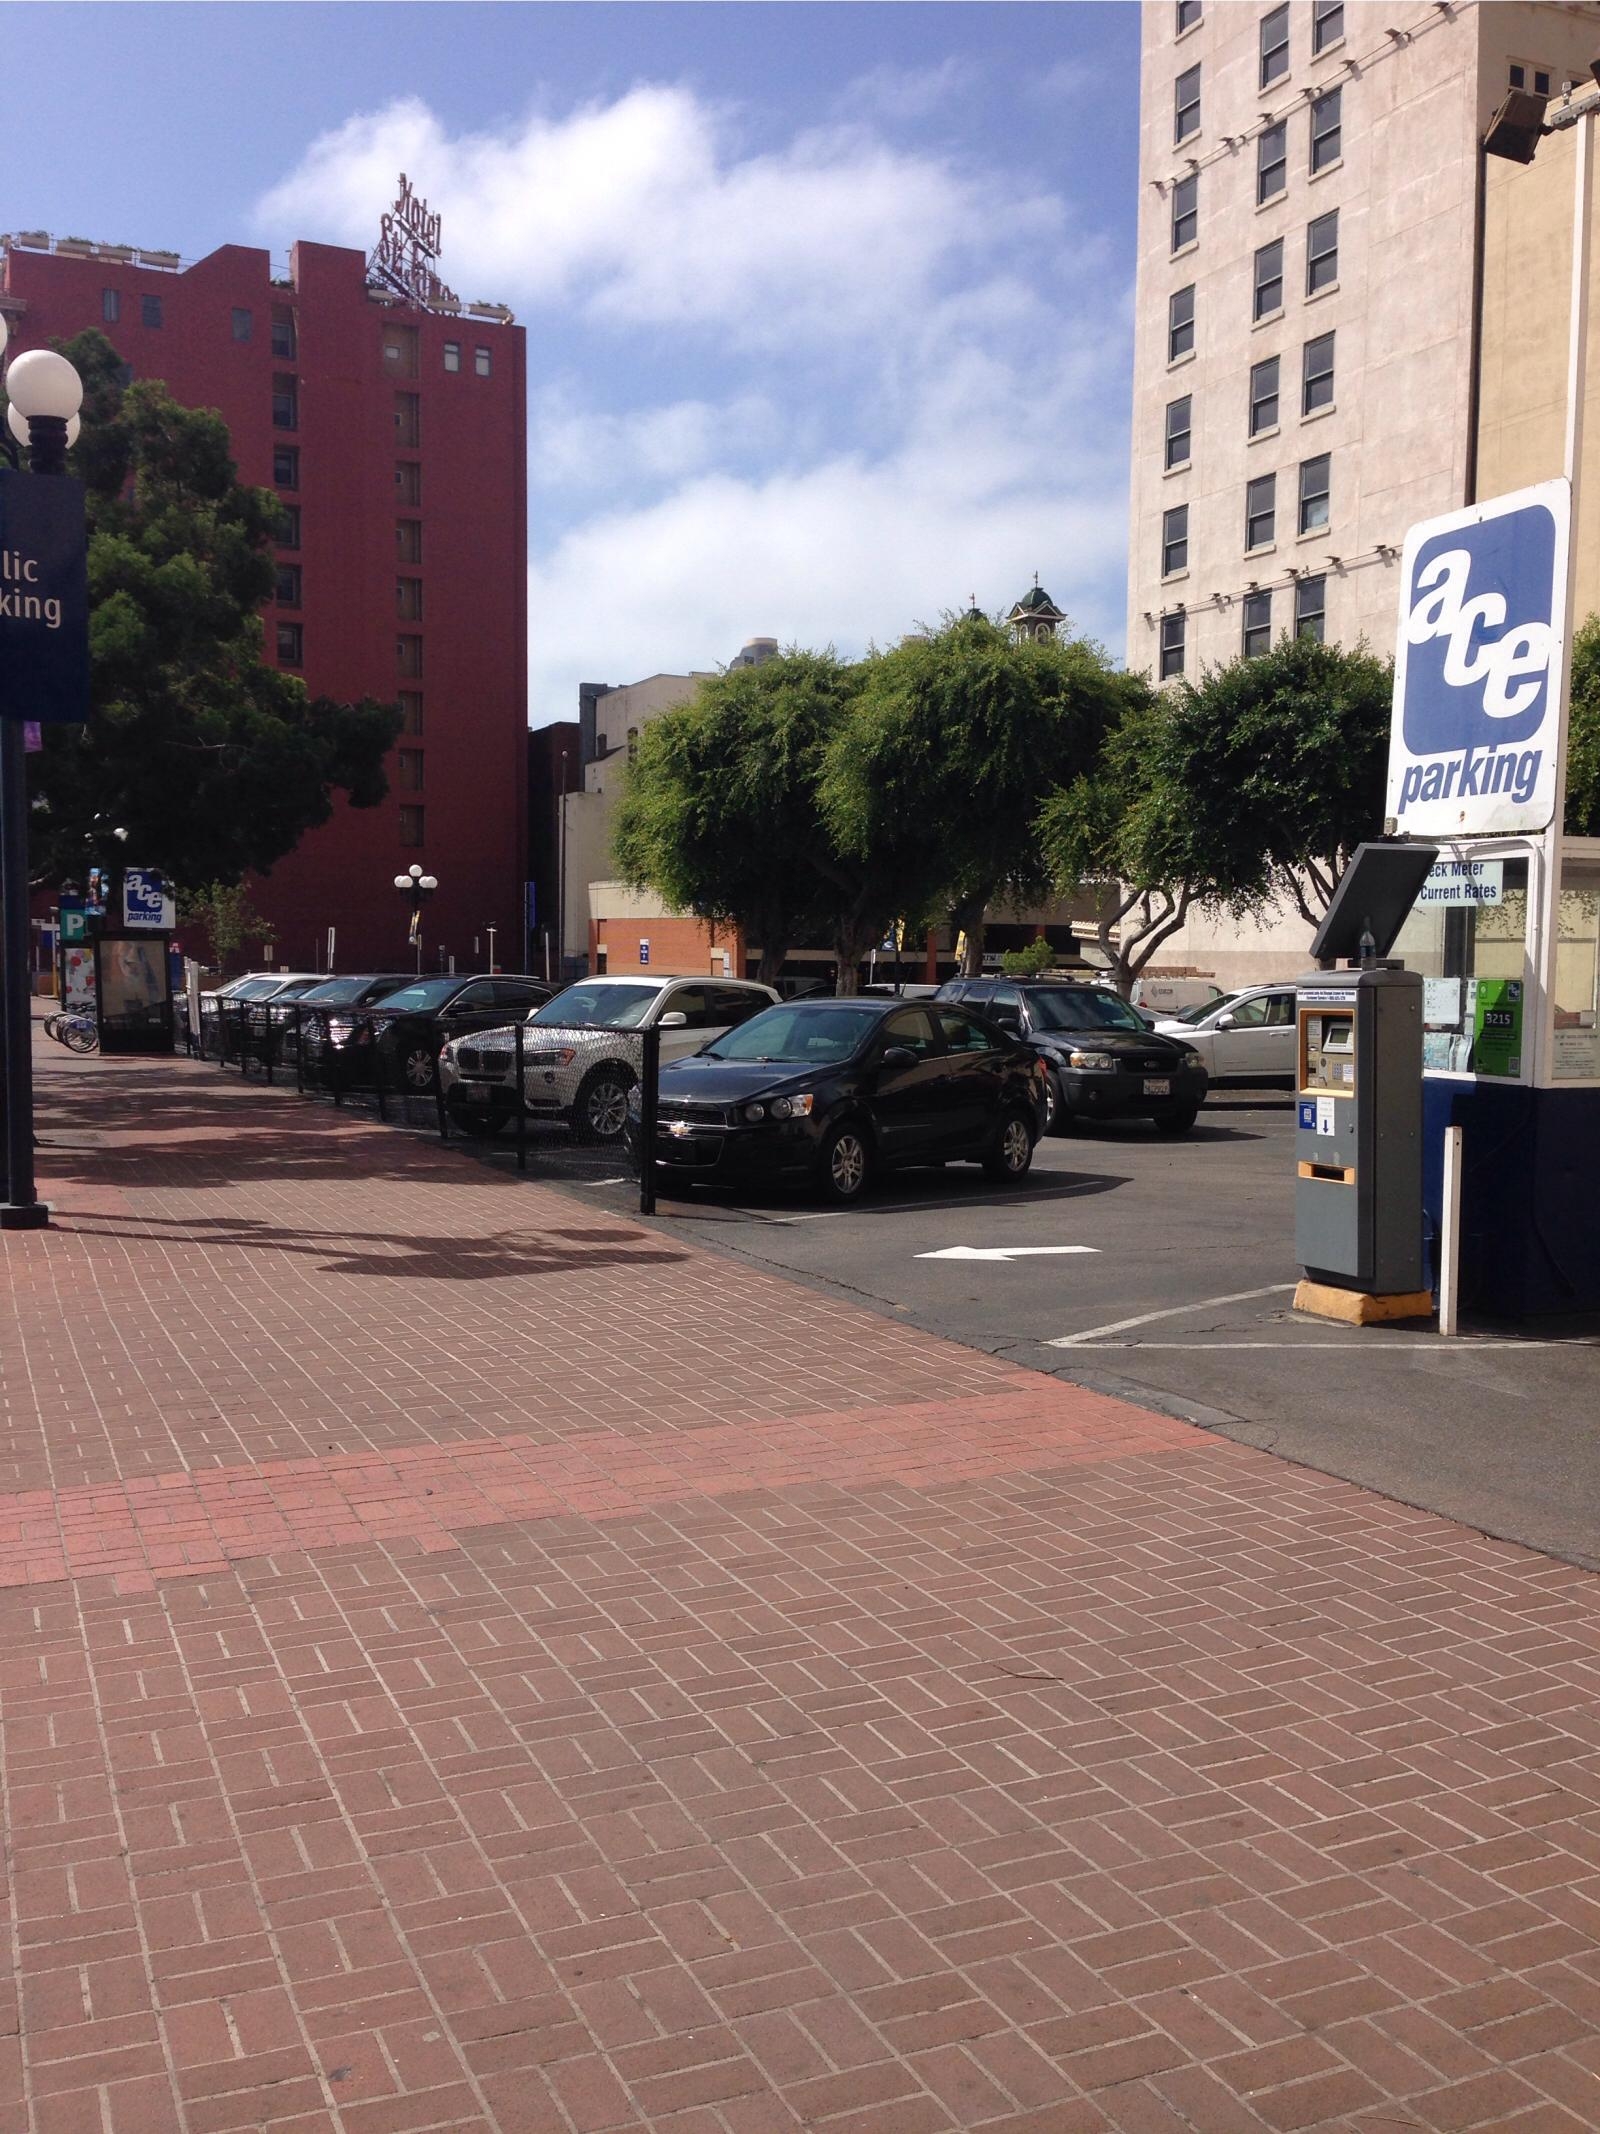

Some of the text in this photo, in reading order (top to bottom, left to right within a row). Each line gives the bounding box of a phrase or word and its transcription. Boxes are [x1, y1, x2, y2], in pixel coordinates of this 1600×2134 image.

[3, 550, 38, 582] lic
[0, 587, 61, 629] king
[1407, 549, 1551, 719] ace
[1398, 745, 1543, 815] parking
[1451, 862, 1485, 877] Meter
[127, 874, 162, 908] ace
[1420, 883, 1497, 900] Current Rates
[66, 914, 84, 936] P
[127, 911, 162, 924] parking
